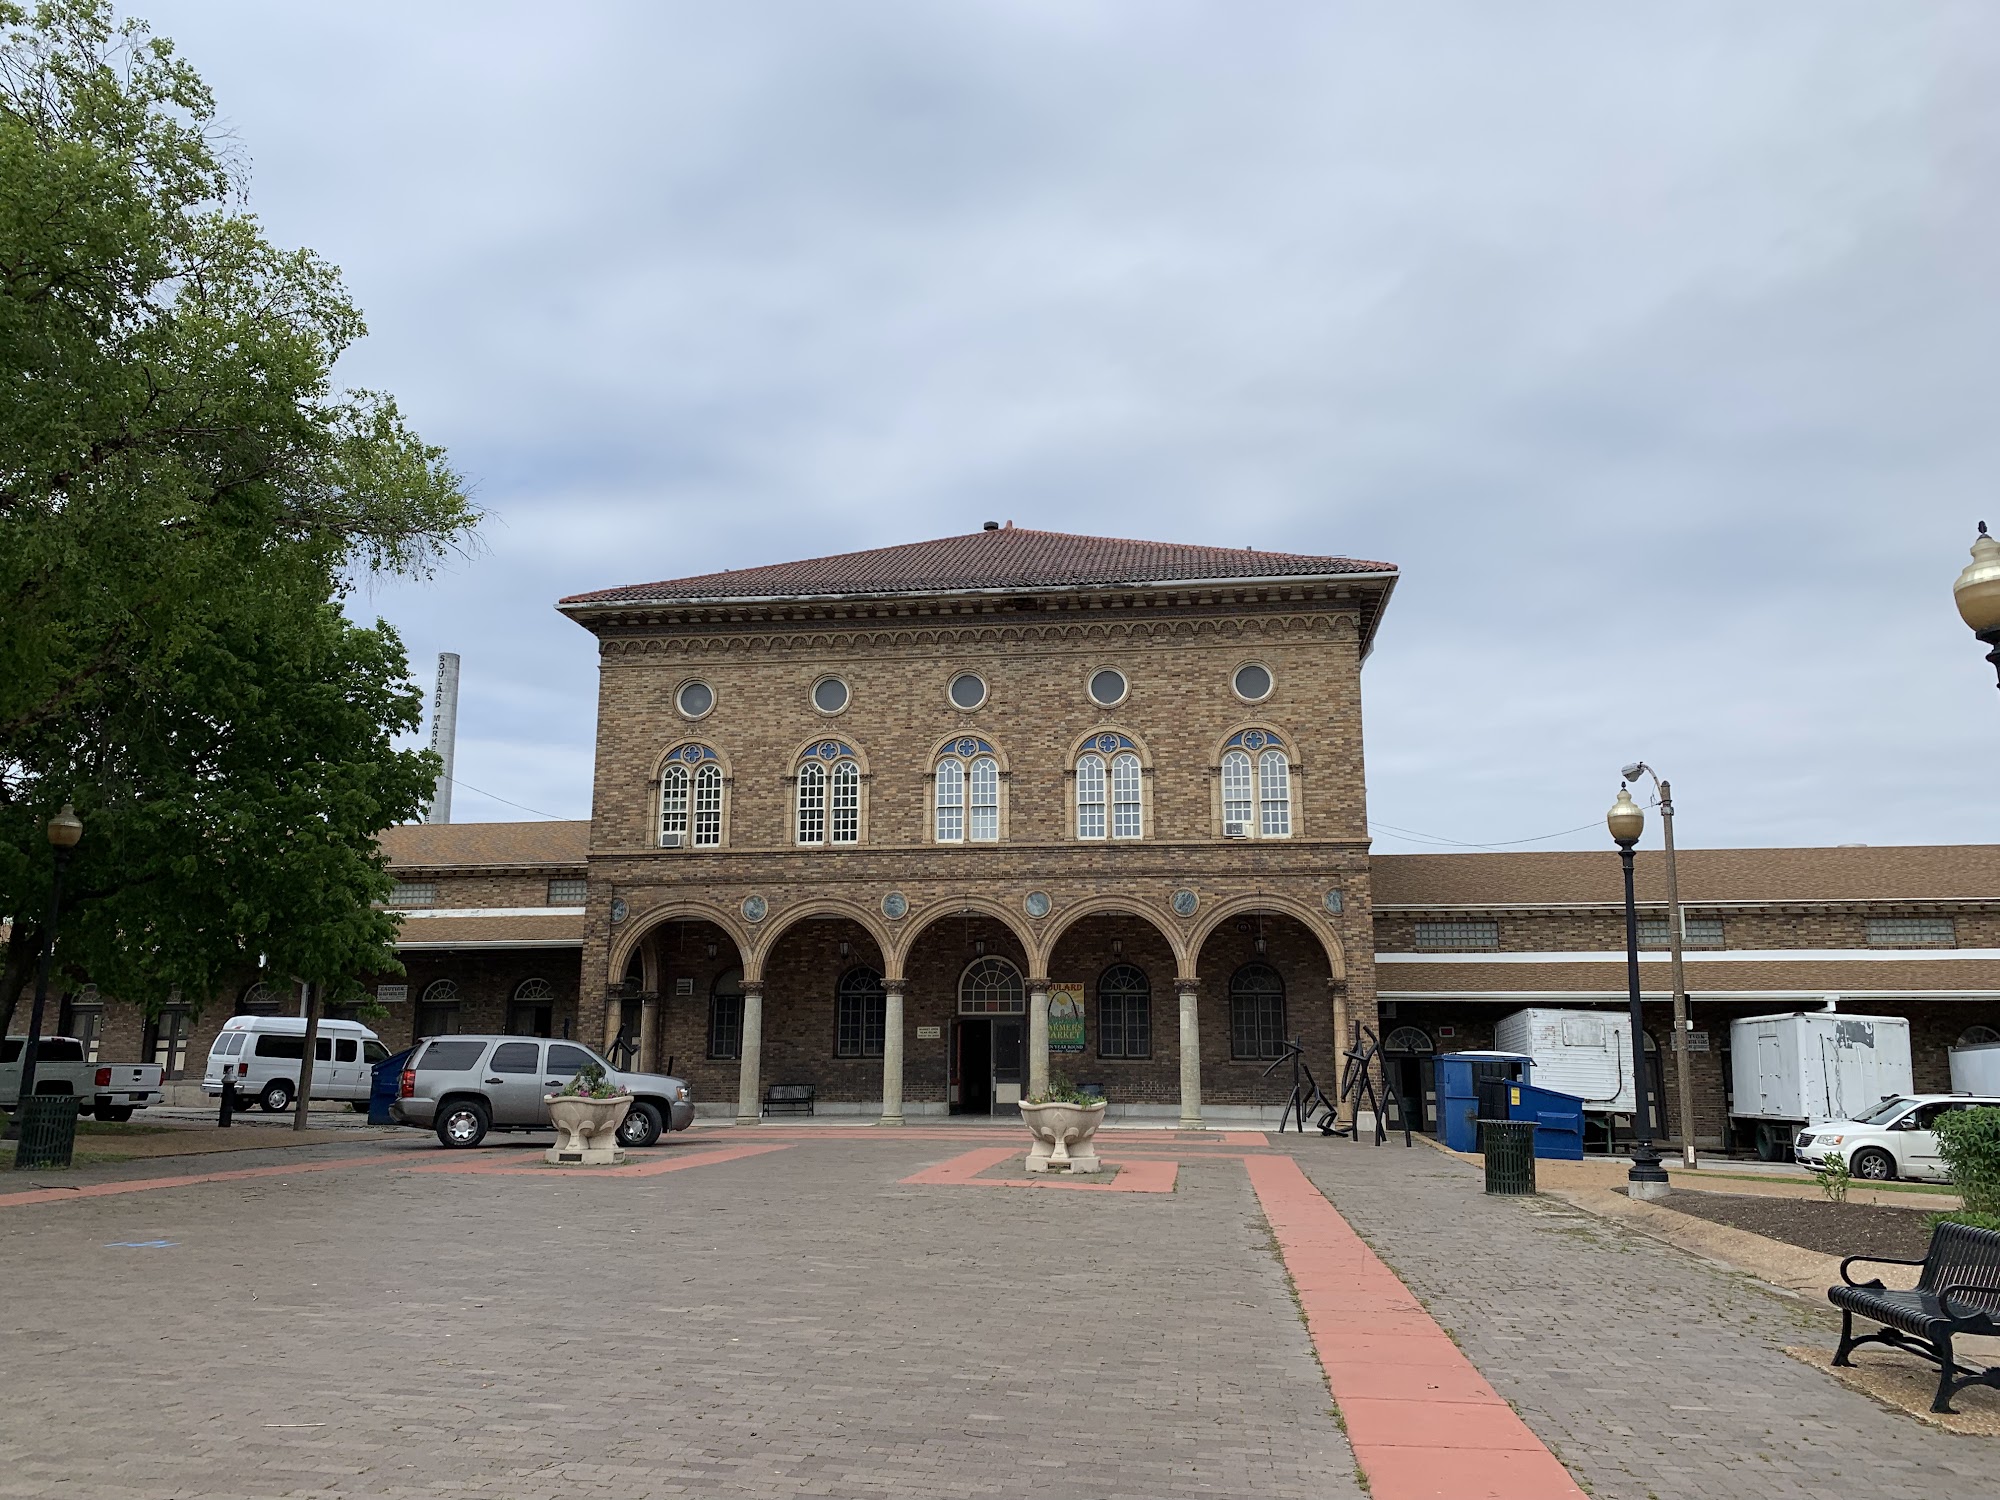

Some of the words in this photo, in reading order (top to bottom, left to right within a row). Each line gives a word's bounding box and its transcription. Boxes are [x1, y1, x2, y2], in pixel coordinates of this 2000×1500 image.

[435, 654, 445, 708] SOULARD
[432, 715, 440, 753] MARKE
[1048, 1031, 1081, 1039] ARKET
